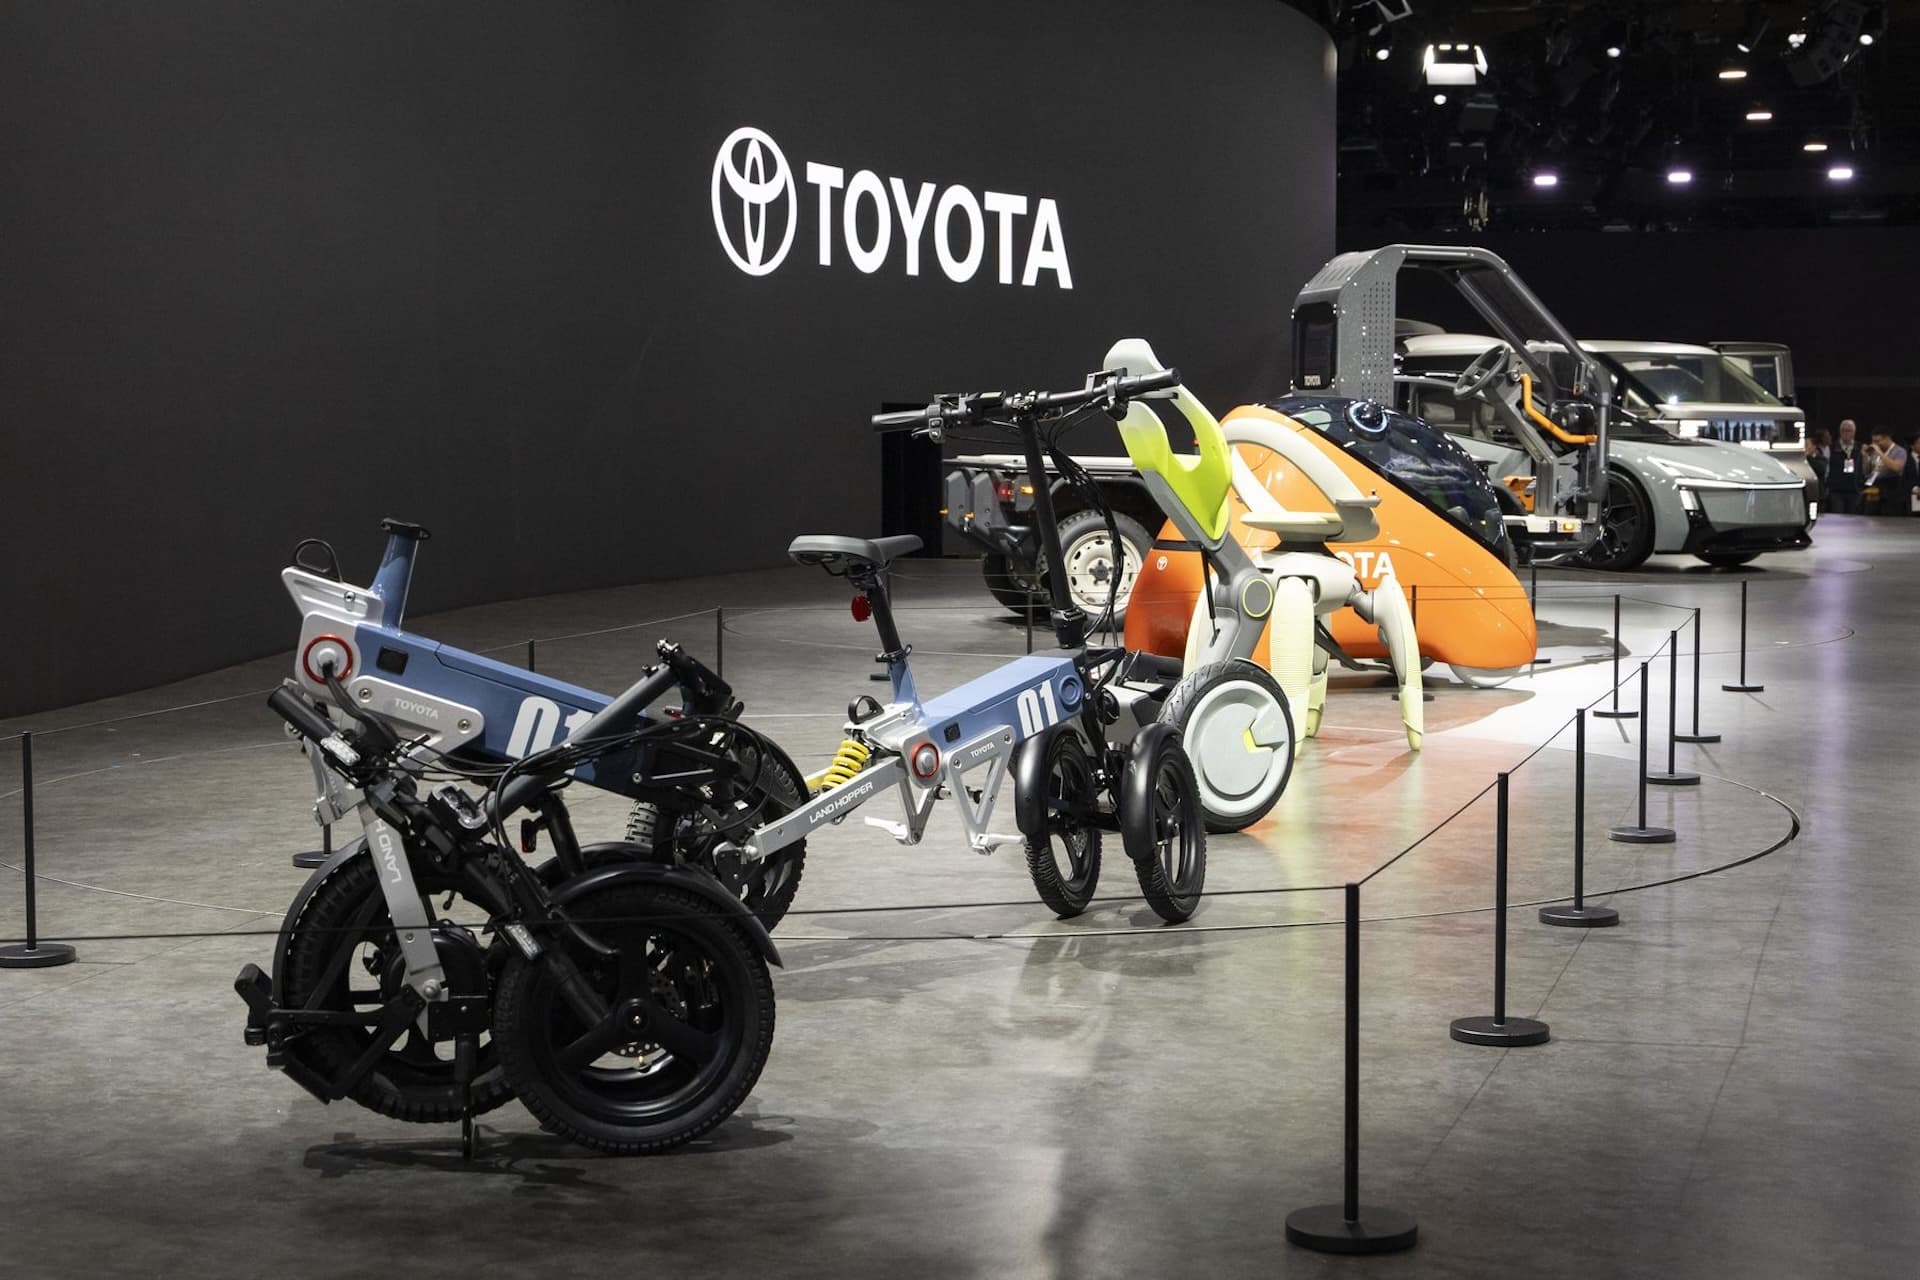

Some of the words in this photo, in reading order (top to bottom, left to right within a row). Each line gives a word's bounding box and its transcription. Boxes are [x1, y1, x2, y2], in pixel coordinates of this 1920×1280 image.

[806, 161, 1073, 289] TOYOTA
[394, 698, 439, 721] TOYOTA
[1017, 679, 1059, 739] 01
[970, 741, 995, 758] TOYOTA
[809, 803, 835, 824] LAND
[834, 781, 873, 809] HOPPER
[378, 834, 402, 884] LAND
